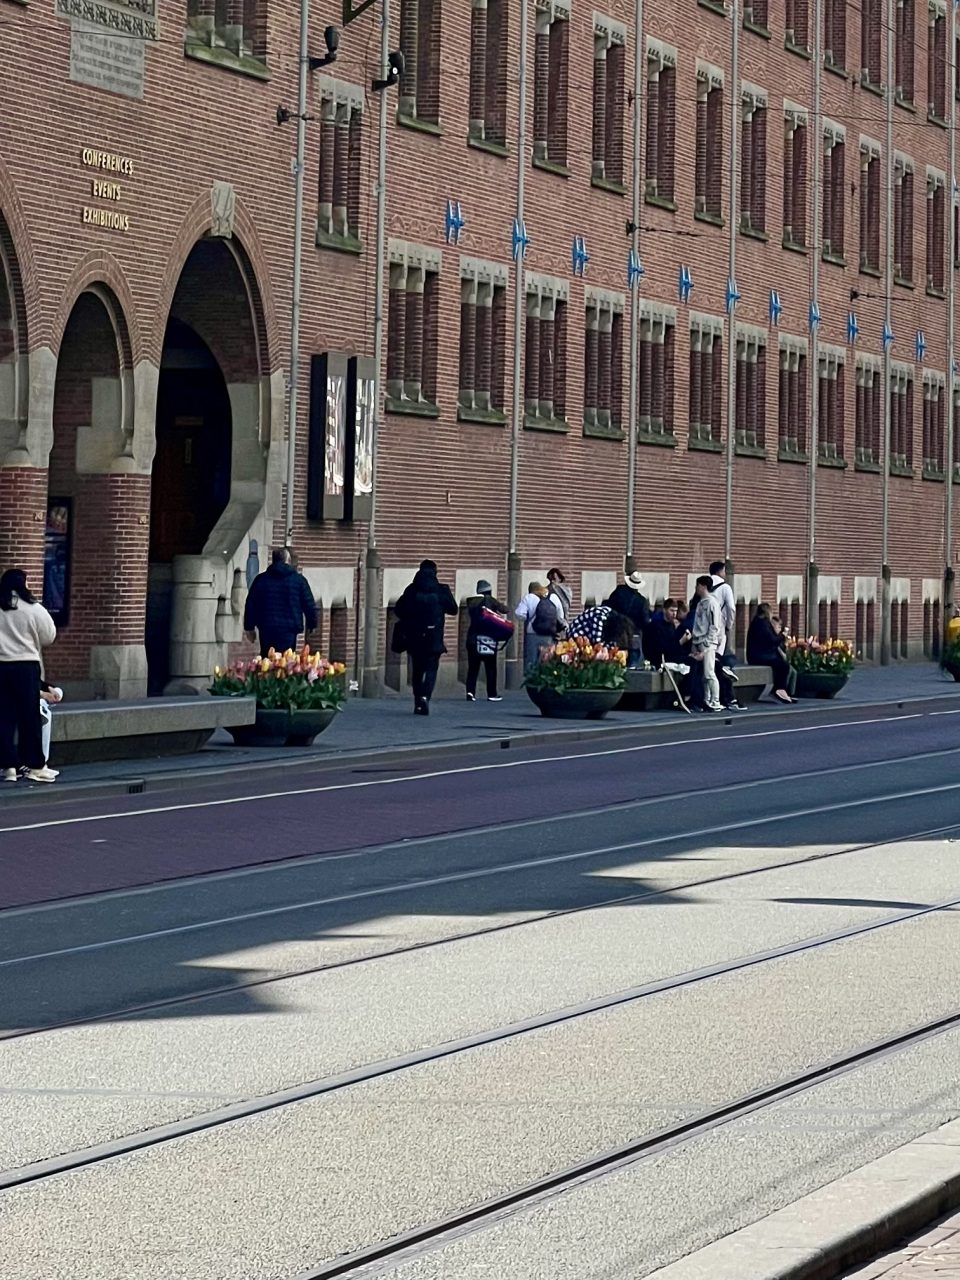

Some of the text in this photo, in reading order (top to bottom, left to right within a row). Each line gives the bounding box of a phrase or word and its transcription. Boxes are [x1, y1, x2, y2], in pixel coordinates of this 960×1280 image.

[82, 148, 134, 175] CONFERENCES
[93, 180, 121, 200] EVENTS
[83, 206, 129, 231] EXHIBITIONS
